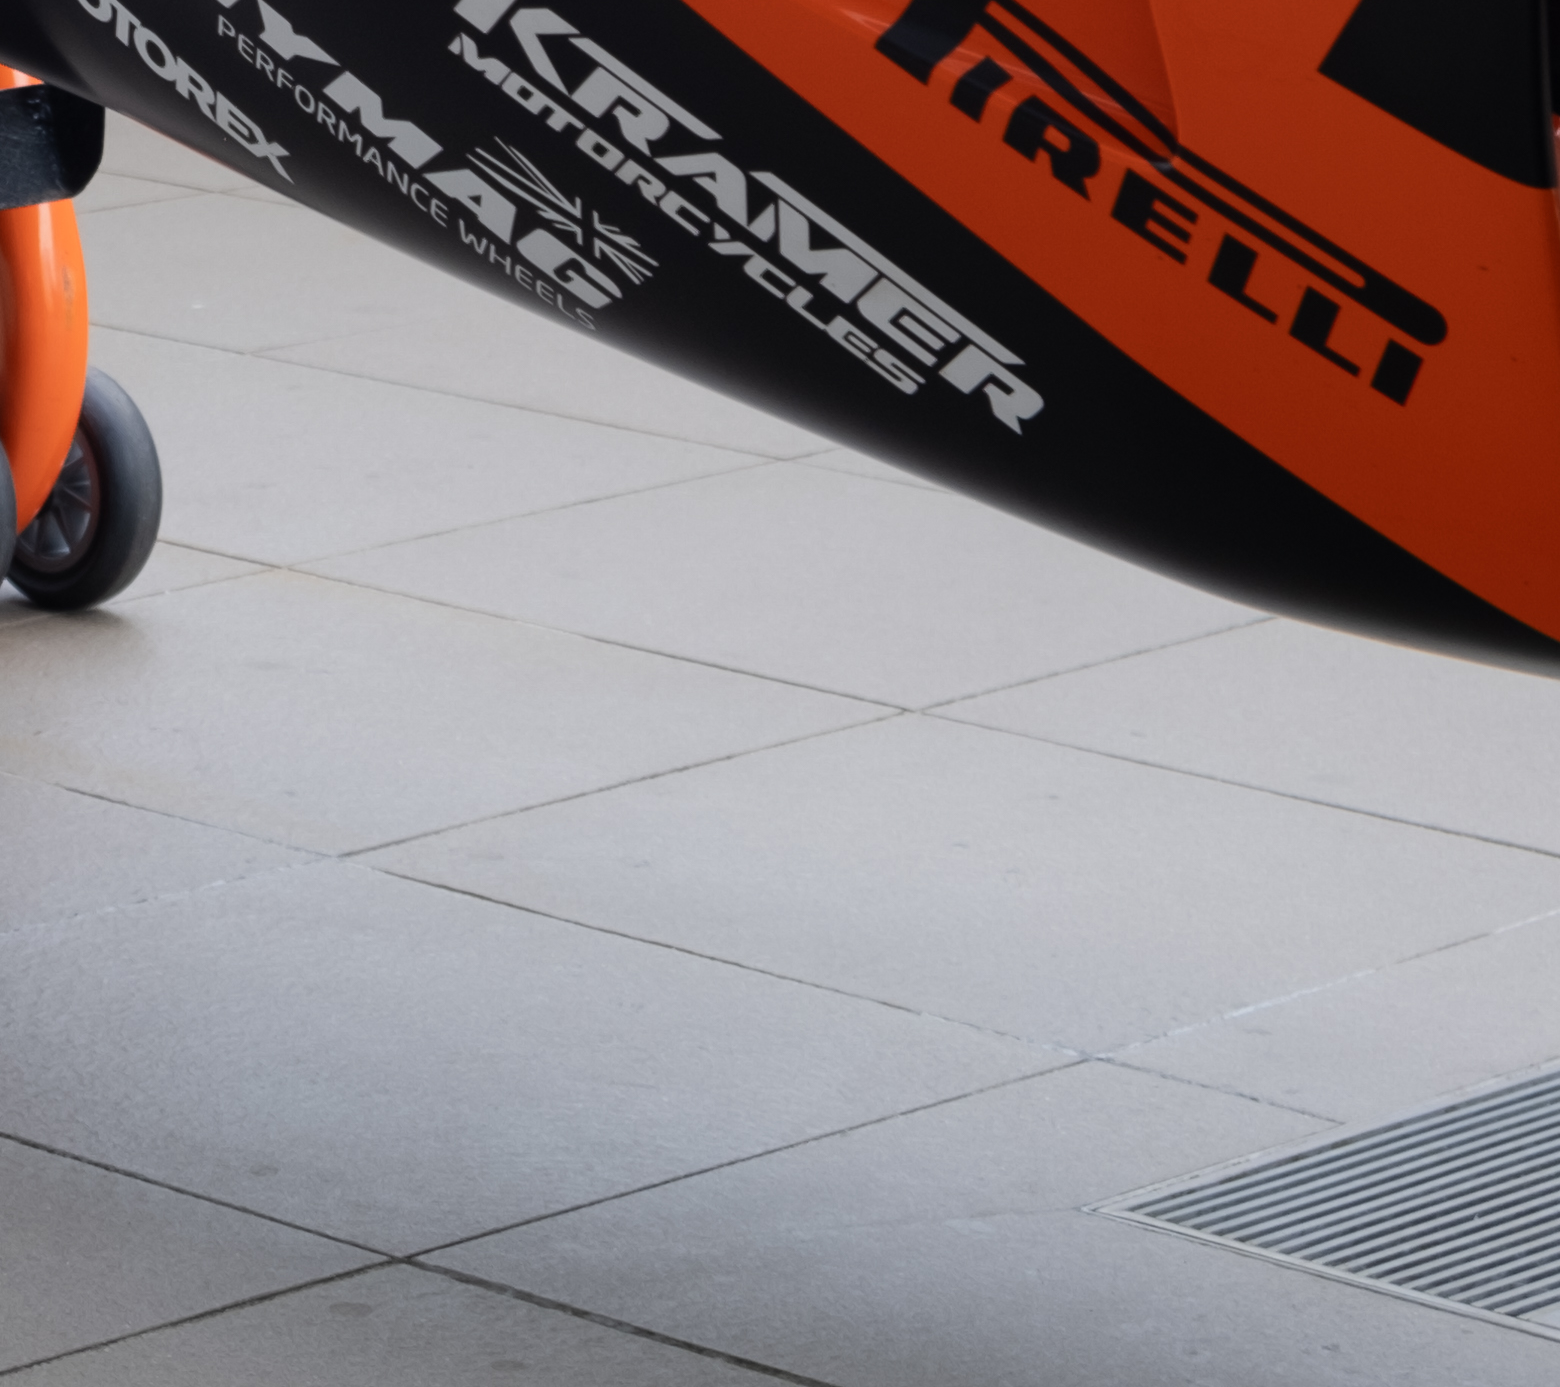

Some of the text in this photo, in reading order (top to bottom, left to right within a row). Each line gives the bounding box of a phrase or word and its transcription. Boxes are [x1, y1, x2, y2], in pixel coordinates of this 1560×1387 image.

[217, 13, 597, 331] PERFORMANCE WHEELS
[447, 31, 927, 394] MOTORCYCLES
